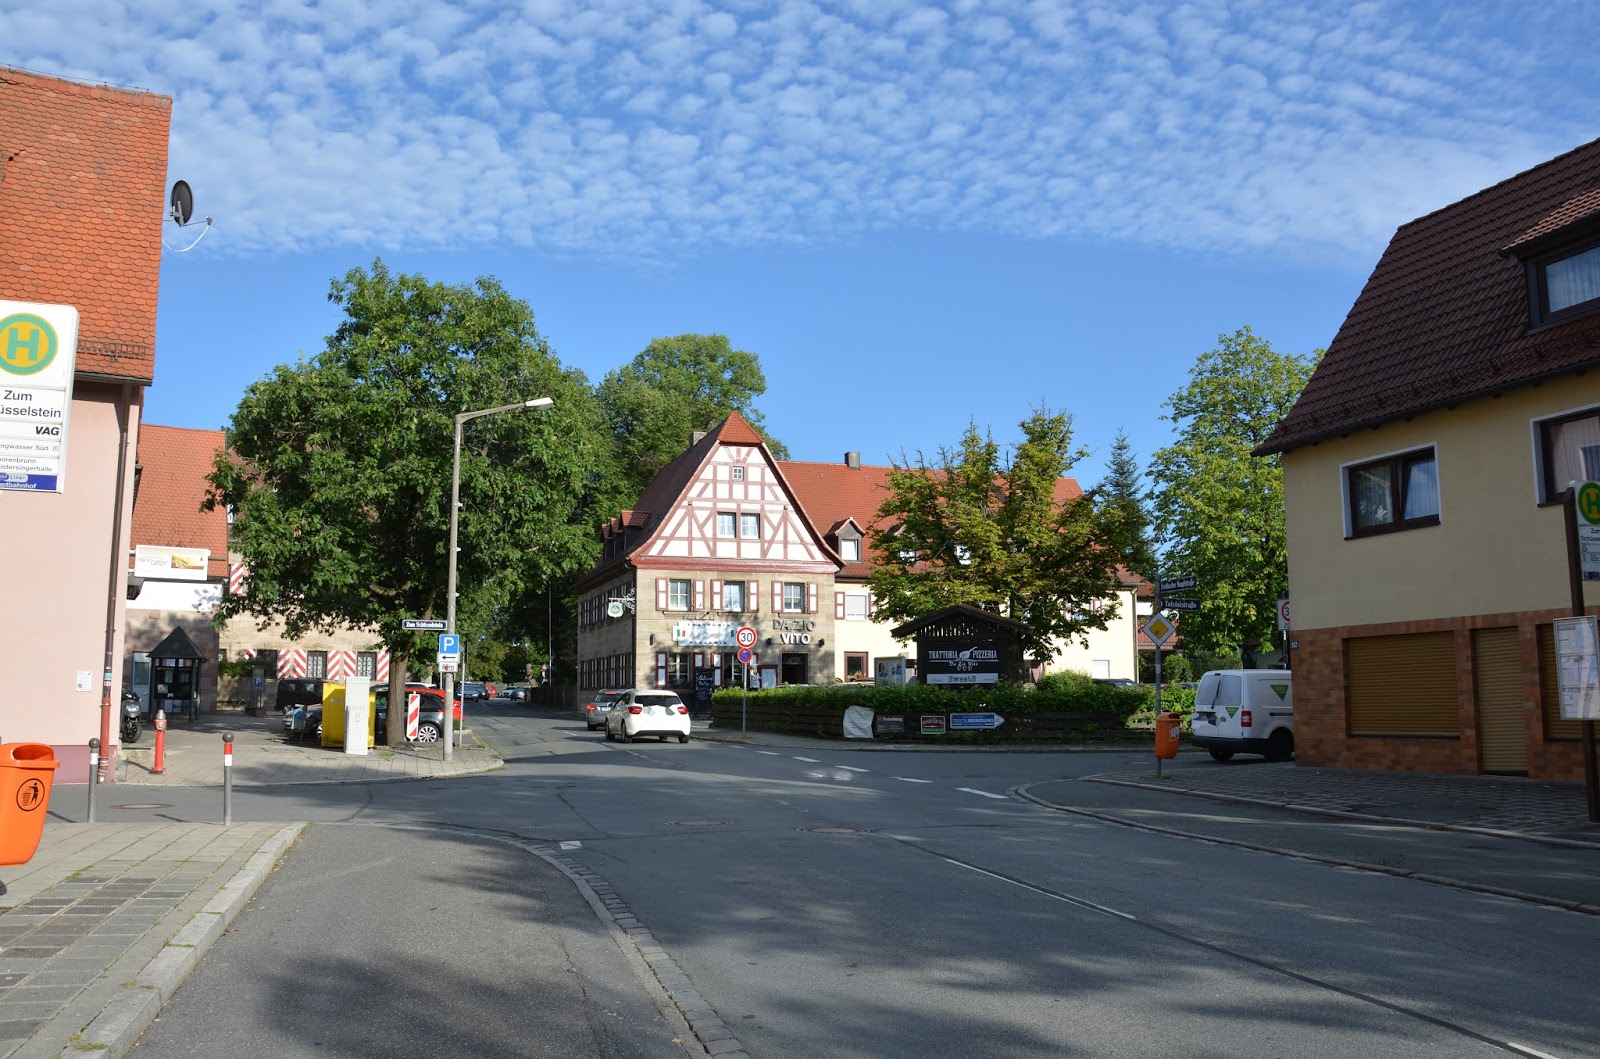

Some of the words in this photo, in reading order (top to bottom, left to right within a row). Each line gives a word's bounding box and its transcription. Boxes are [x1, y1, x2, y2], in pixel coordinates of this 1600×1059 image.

[4, 389, 33, 401] Zum
[35, 426, 60, 436] VAG
[773, 619, 789, 631] DA
[792, 619, 816, 632] ZIO
[740, 632, 753, 643] 30
[780, 632, 811, 645] VITO
[444, 637, 454, 651] P
[928, 650, 958, 659] TRATTORIA
[972, 650, 998, 659] PIZZERIA
